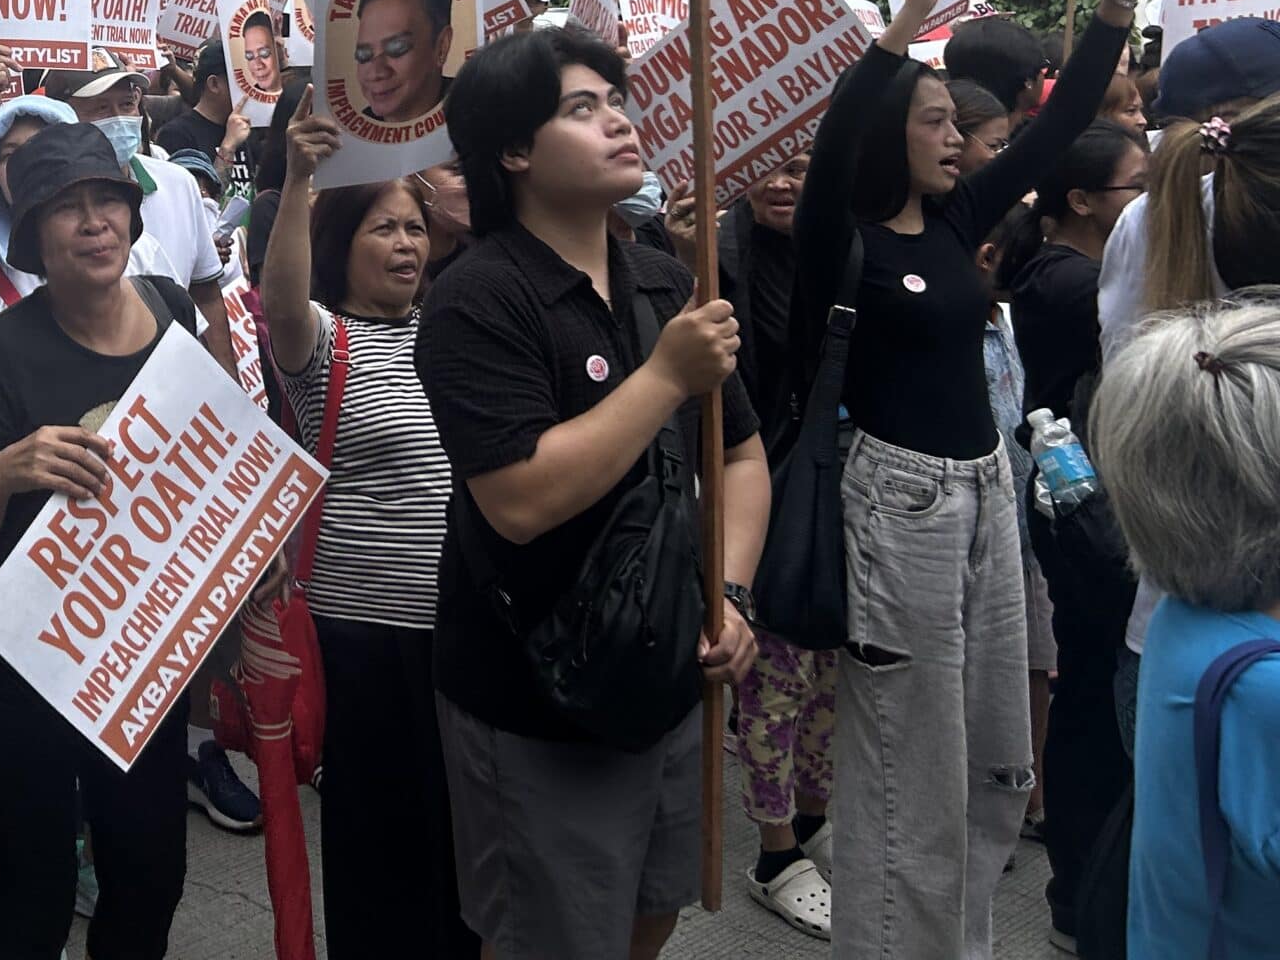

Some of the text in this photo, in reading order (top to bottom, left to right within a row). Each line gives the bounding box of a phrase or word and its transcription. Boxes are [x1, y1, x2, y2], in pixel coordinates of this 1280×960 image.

[107, 25, 151, 44] TRIAL NOW!
[174, 12, 211, 39] TRIAL
[230, 5, 247, 39] TAMA
[625, 17, 650, 36] MGA
[10, 47, 81, 64] RTYLIST
[749, 25, 868, 127] SA BAYAN!
[328, 79, 445, 144] IMPEACHMENT COU
[633, 92, 693, 160] MGA
[715, 149, 781, 203] BAYAN
[27, 394, 172, 590] RESPECT
[38, 402, 238, 667] YOUR OATH!
[71, 550, 196, 722] IMPEACHMENT
[180, 493, 241, 564] TRIAL
[222, 431, 282, 508] NOW!
[119, 606, 219, 747] AKBAYAN
[208, 471, 313, 610] PARTYLIST
